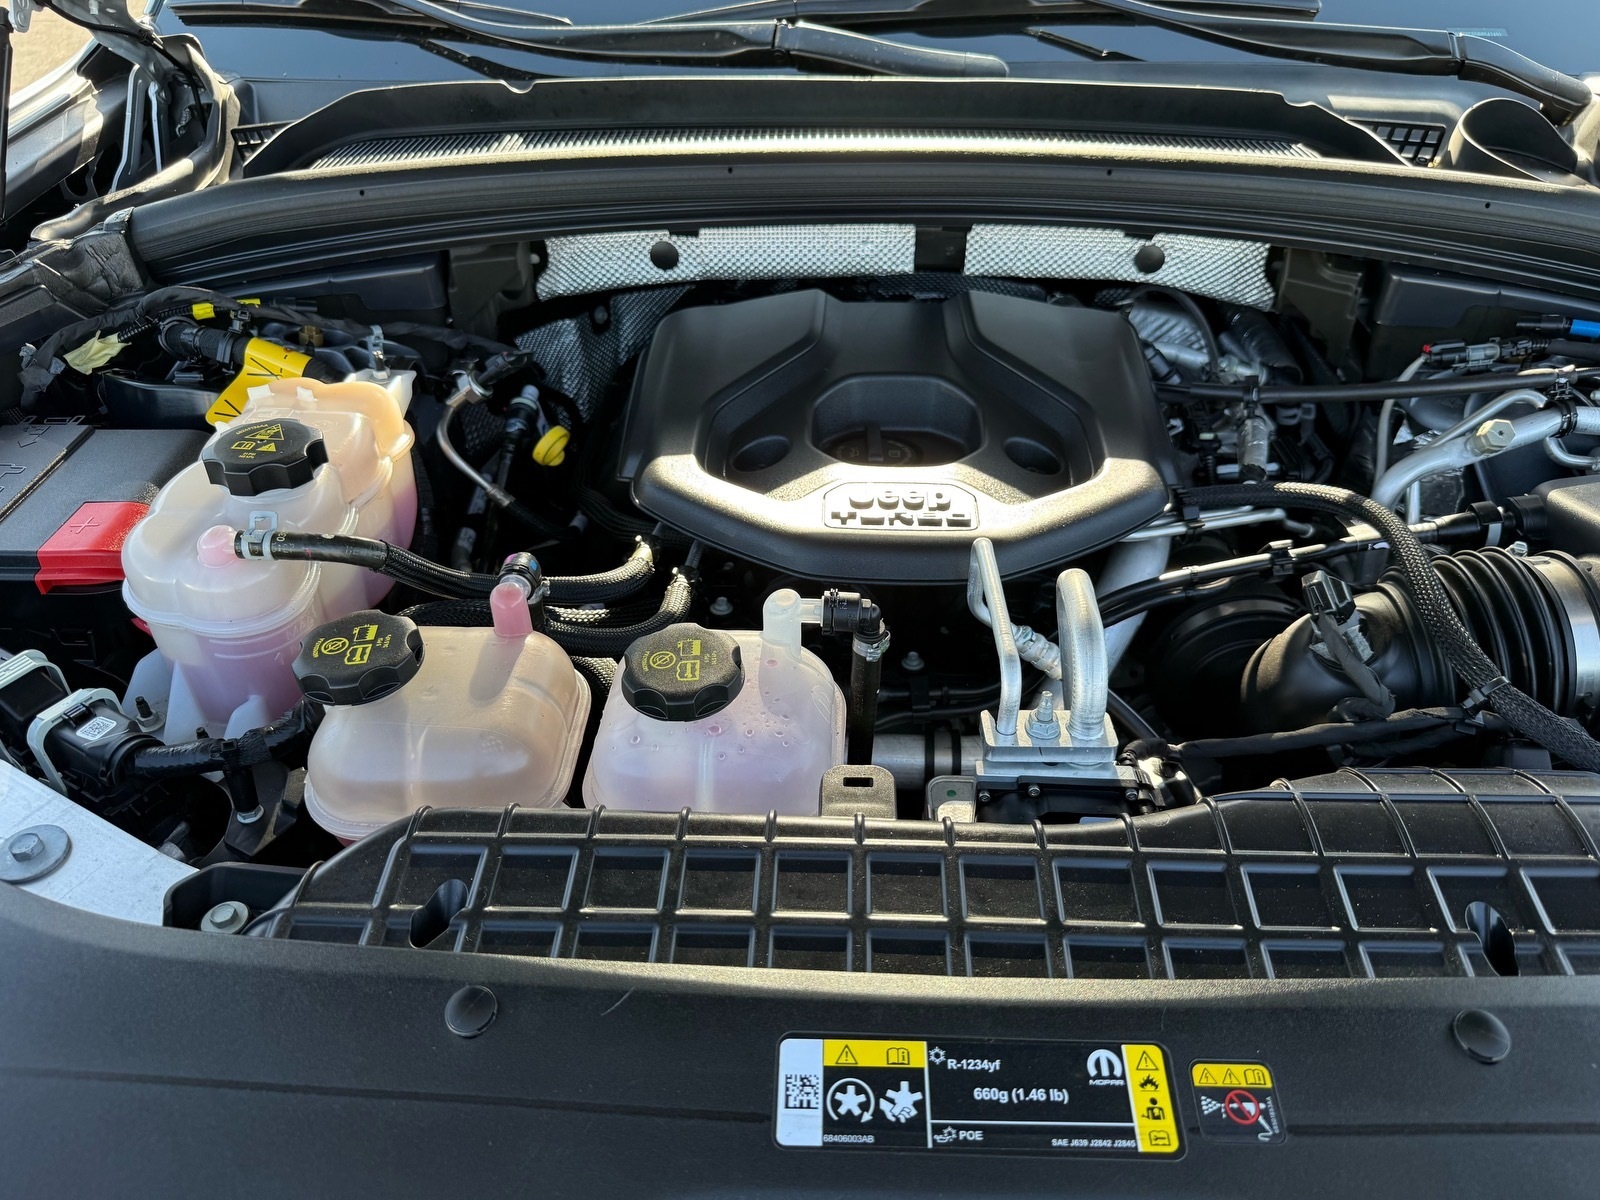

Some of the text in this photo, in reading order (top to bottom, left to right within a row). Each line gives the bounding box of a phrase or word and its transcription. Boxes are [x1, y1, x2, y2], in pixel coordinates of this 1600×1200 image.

[947, 1059, 1001, 1073] R-1234yf
[973, 1088, 1069, 1104] 660g (1.46 lb)
[823, 1134, 875, 1143] 68406003AB
[959, 1131, 984, 1140] POE
[1051, 1138, 1136, 1148] SAE J639 J2842 J2845
